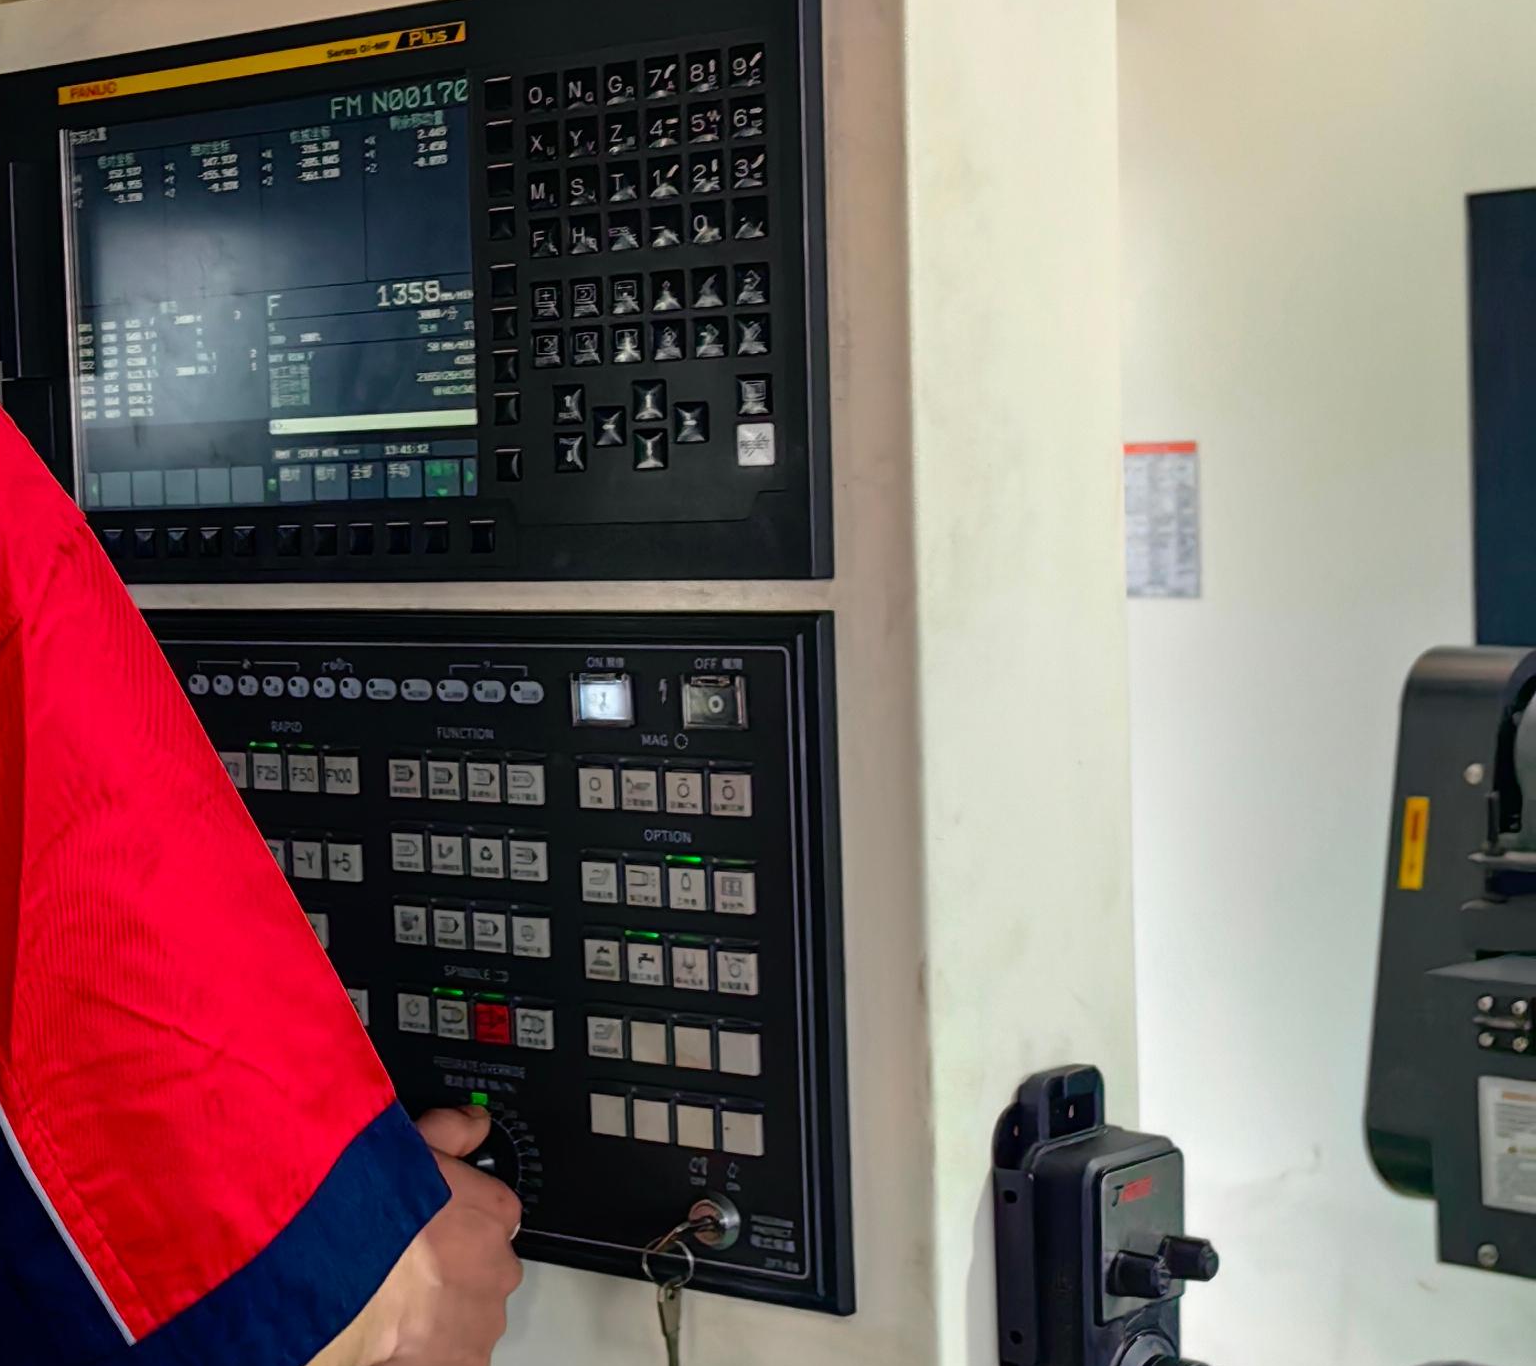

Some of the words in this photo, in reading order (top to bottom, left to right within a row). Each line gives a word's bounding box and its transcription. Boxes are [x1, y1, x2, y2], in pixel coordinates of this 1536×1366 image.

[408, 30, 447, 46] Plus
[732, 57, 747, 76] 9
[69, 80, 117, 100] FANUC
[330, 93, 362, 120] FM
[371, 78, 468, 114] N00170
[733, 108, 748, 127] 6
[734, 158, 749, 178] 3
[376, 279, 441, 307] 1358
[694, 657, 717, 669] OFF
[436, 726, 495, 741] FUNCTION
[641, 734, 668, 747] MAG
[255, 764, 279, 782] F25
[292, 766, 315, 783] F50
[326, 768, 353, 784] F100
[643, 828, 692, 844] OPTION
